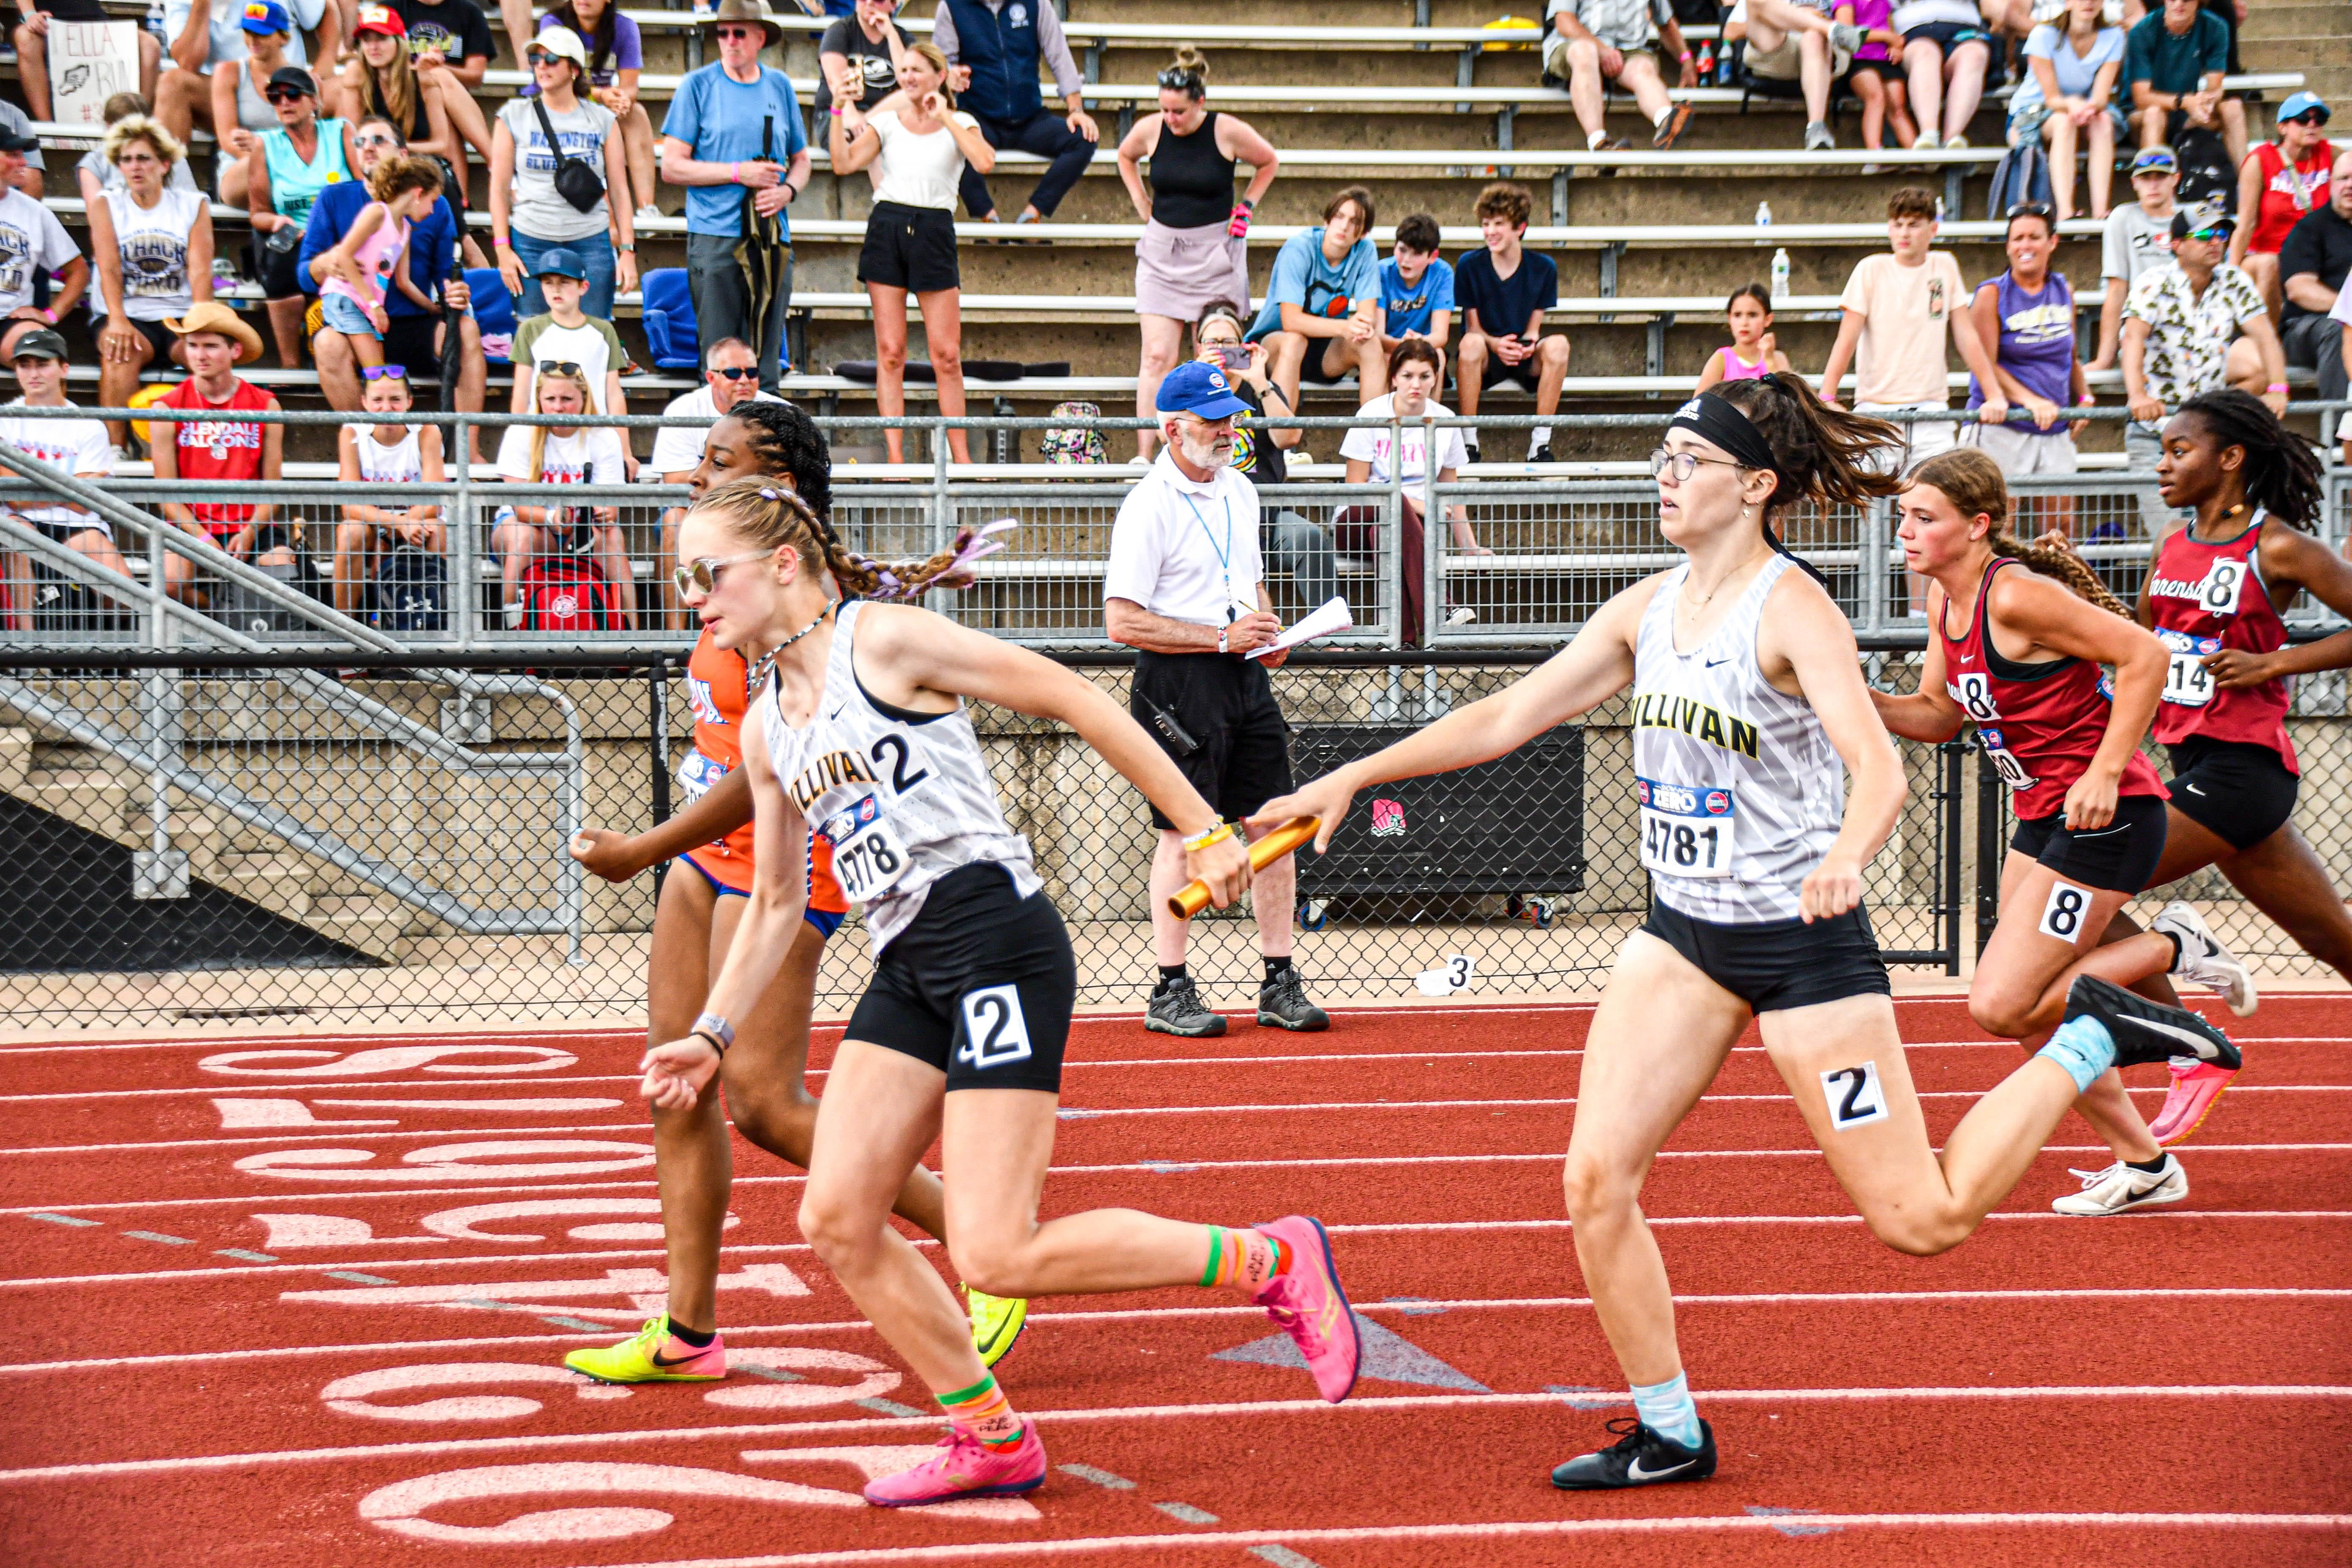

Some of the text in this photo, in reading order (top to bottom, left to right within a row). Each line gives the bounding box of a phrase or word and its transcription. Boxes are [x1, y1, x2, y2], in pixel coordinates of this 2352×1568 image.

[66, 23, 117, 56] ELLA
[179, 435, 260, 448] FALCONS
[2207, 566, 2236, 607] 8
[1966, 678, 1991, 719] 8
[871, 733, 929, 796] 2
[837, 832, 900, 897] 4778
[1647, 817, 1718, 868] 4781
[2048, 889, 2082, 935] 8
[1449, 958, 1468, 987] 3
[973, 993, 1020, 1059] 2
[1828, 1067, 1877, 1122] 2
